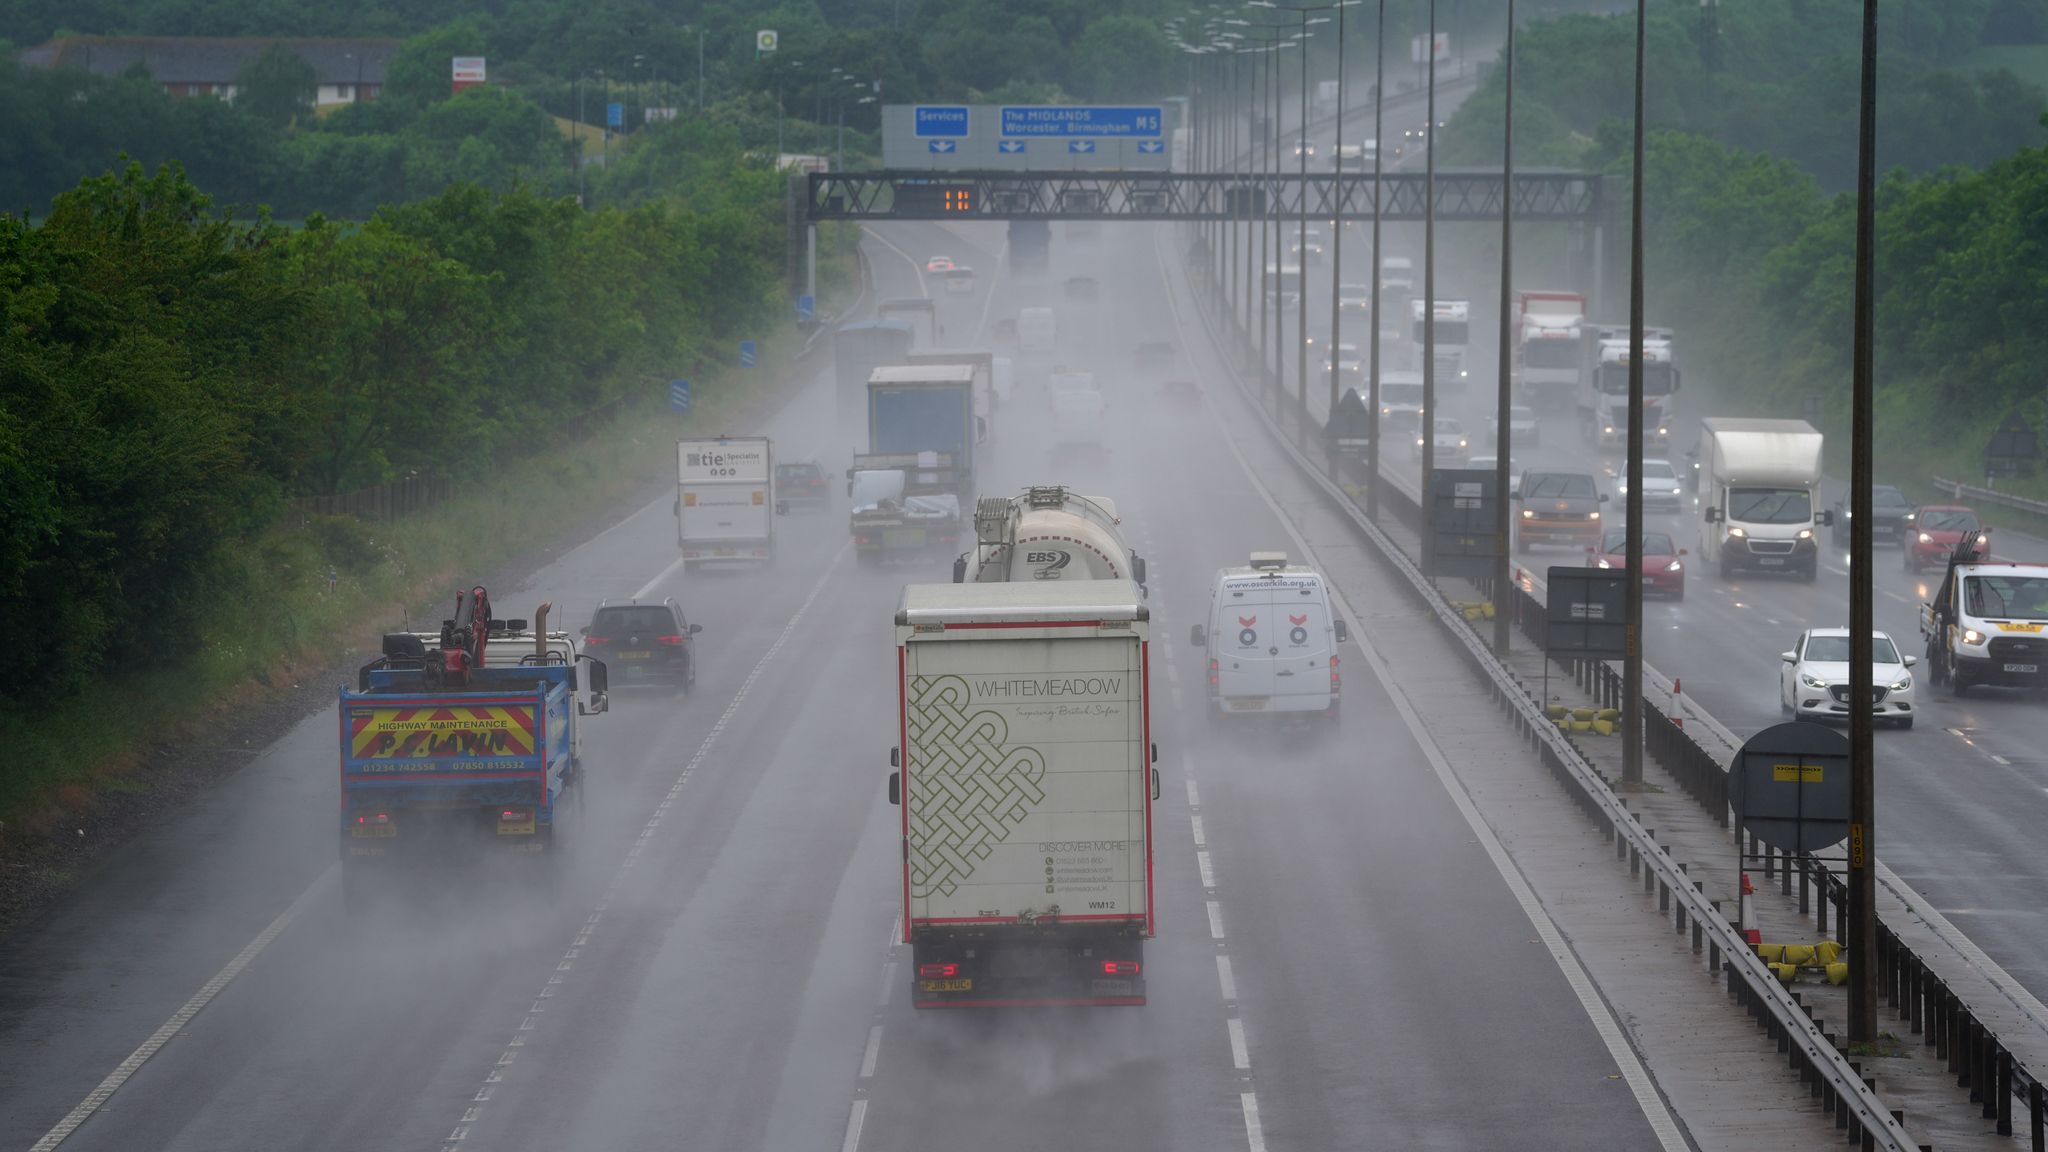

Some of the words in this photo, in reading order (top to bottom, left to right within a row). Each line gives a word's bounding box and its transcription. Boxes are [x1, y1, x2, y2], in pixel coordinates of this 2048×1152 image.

[919, 111, 965, 122] Services
[1005, 111, 1024, 121] The
[1027, 111, 1091, 121] MIDLANDS
[1067, 122, 1131, 134] Birmingham
[702, 452, 724, 466] tie
[1027, 551, 1057, 563] EBS
[1226, 579, 1317, 589] www.oscarkilo.org.uk
[975, 678, 1121, 697] WHITEMEADOW
[378, 721, 427, 731] HIGHWAY
[430, 720, 508, 730] MAINTENANCE
[363, 764, 395, 773] 01234
[452, 762, 484, 770] 07850
[1039, 841, 1092, 852] DISCOVER
[1094, 840, 1127, 851] MORE
[1088, 901, 1116, 909] WM12
